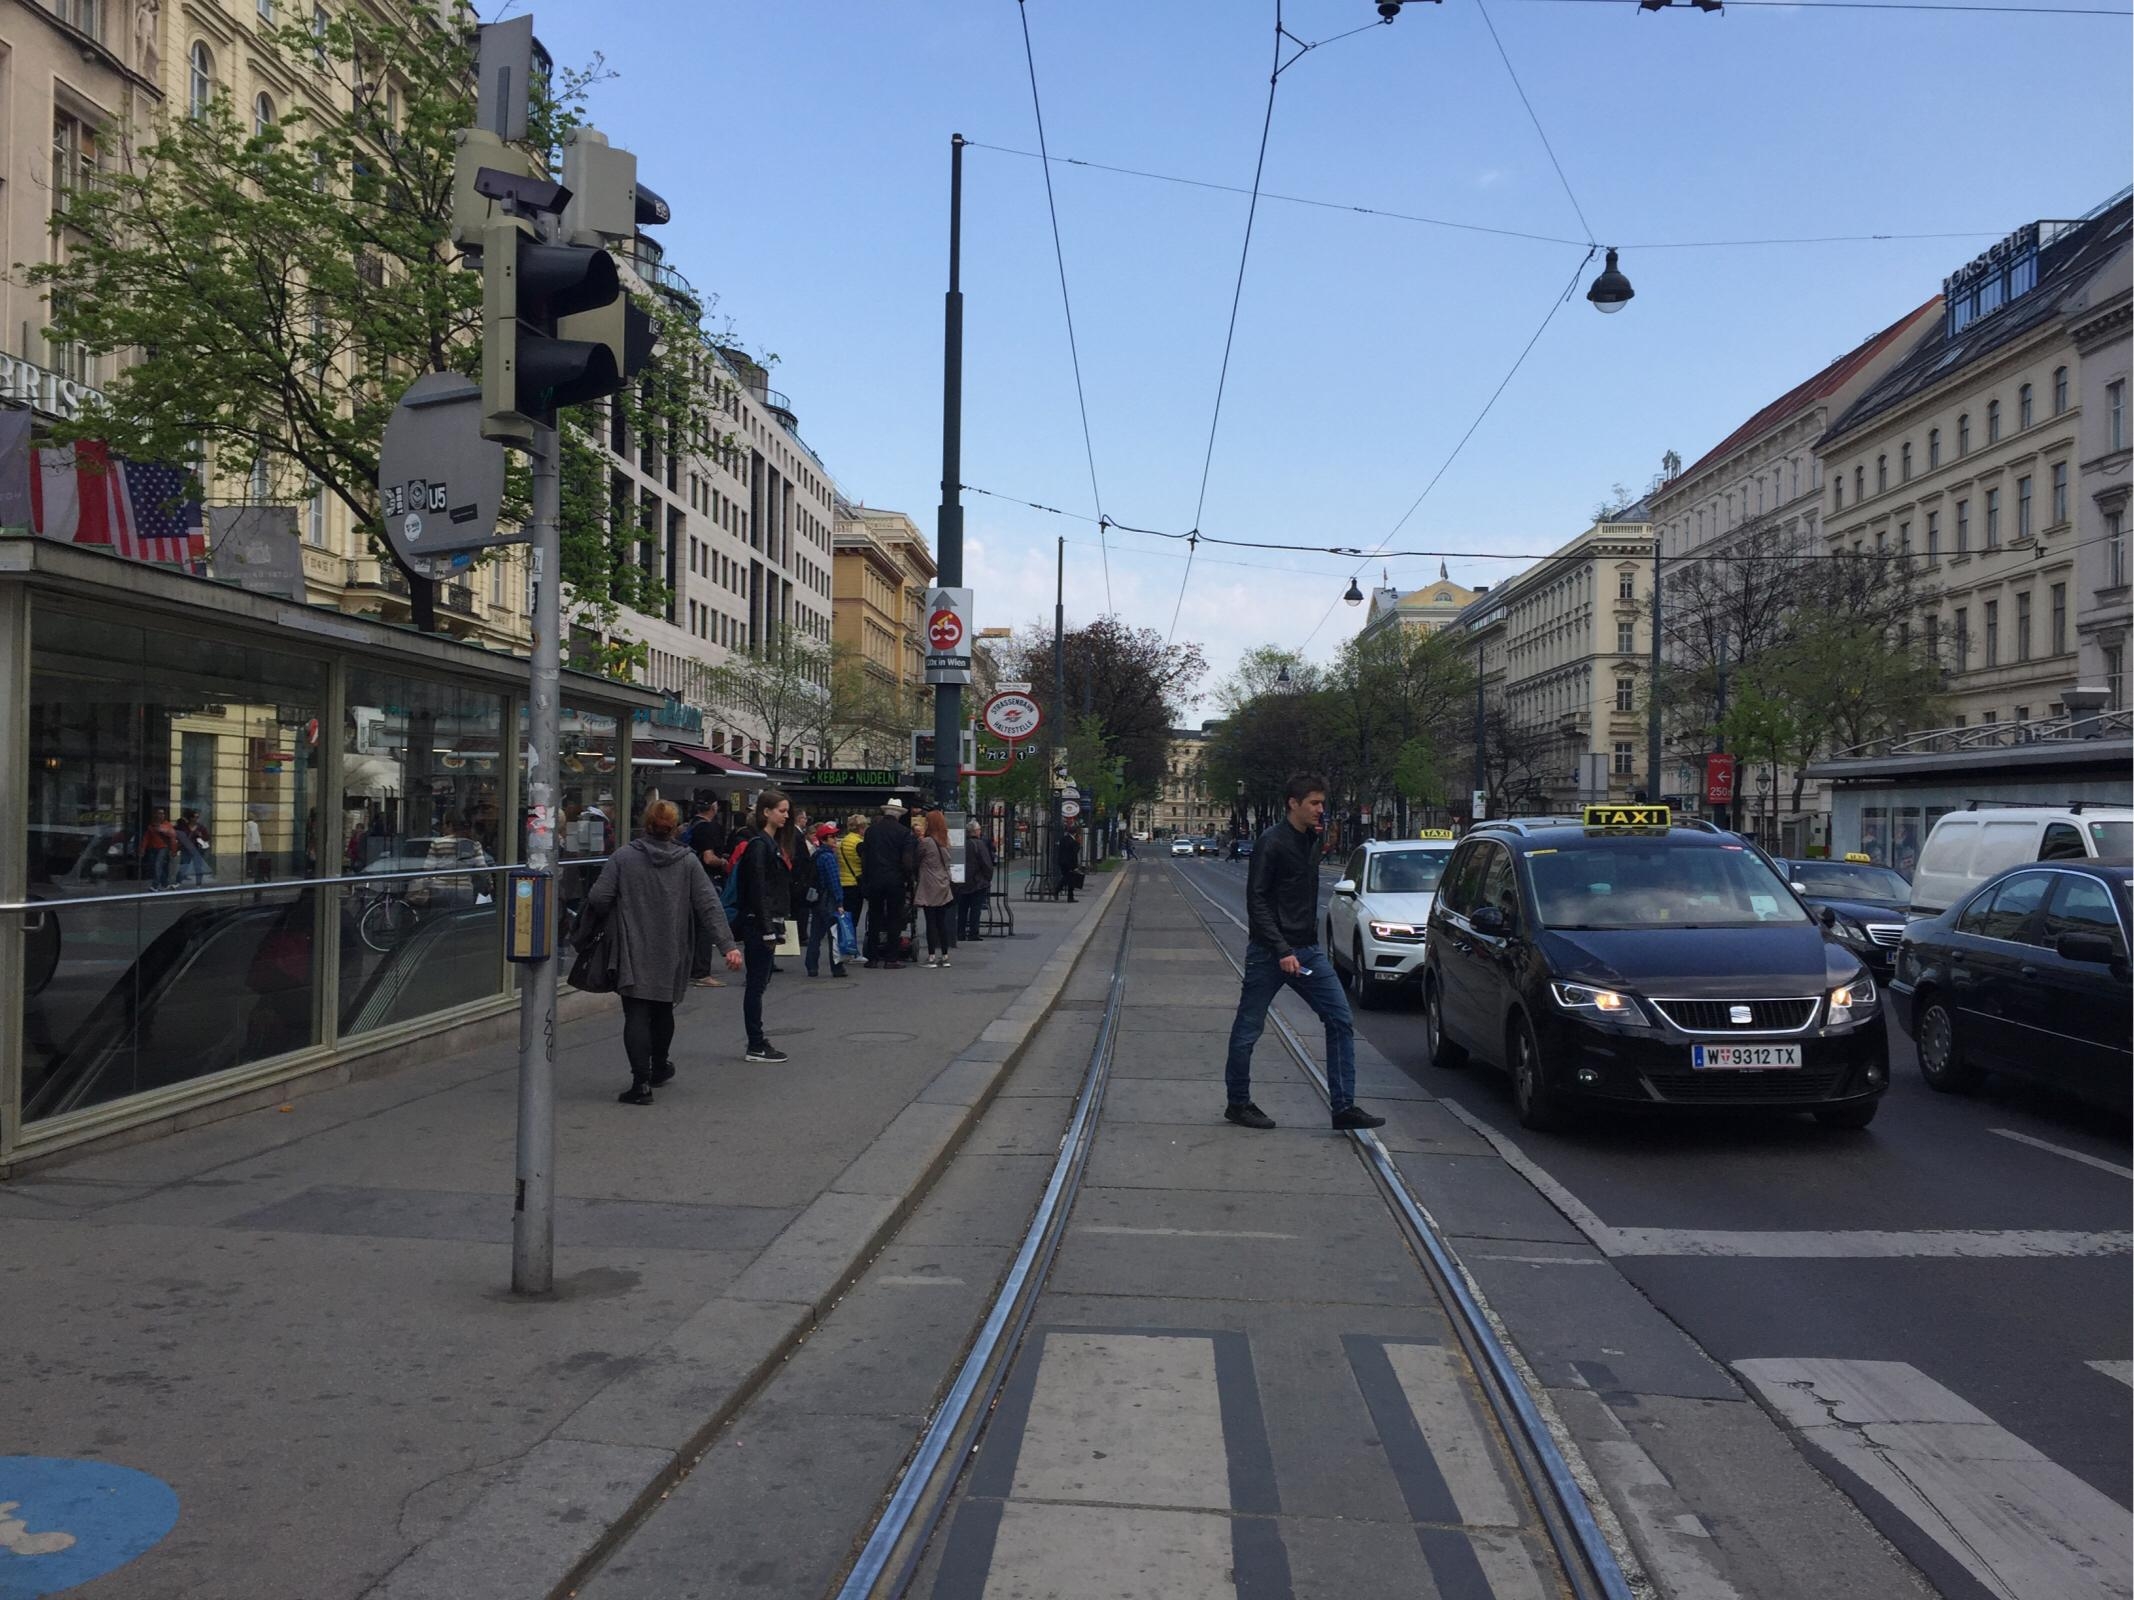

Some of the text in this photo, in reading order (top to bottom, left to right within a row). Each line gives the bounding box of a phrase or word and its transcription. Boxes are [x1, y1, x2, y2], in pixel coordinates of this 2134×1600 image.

[429, 486, 447, 510] U5
[947, 657, 967, 667] Wien
[991, 698, 1035, 715] STRASSENBAHN
[993, 720, 1034, 734] HALTESTELLE
[817, 771, 848, 785] KEBAP
[856, 771, 895, 785] NUDELN
[1595, 811, 1659, 824] TAXI
[1425, 829, 1450, 838] TAXI
[1707, 1048, 1796, 1065] W 9312 TX
